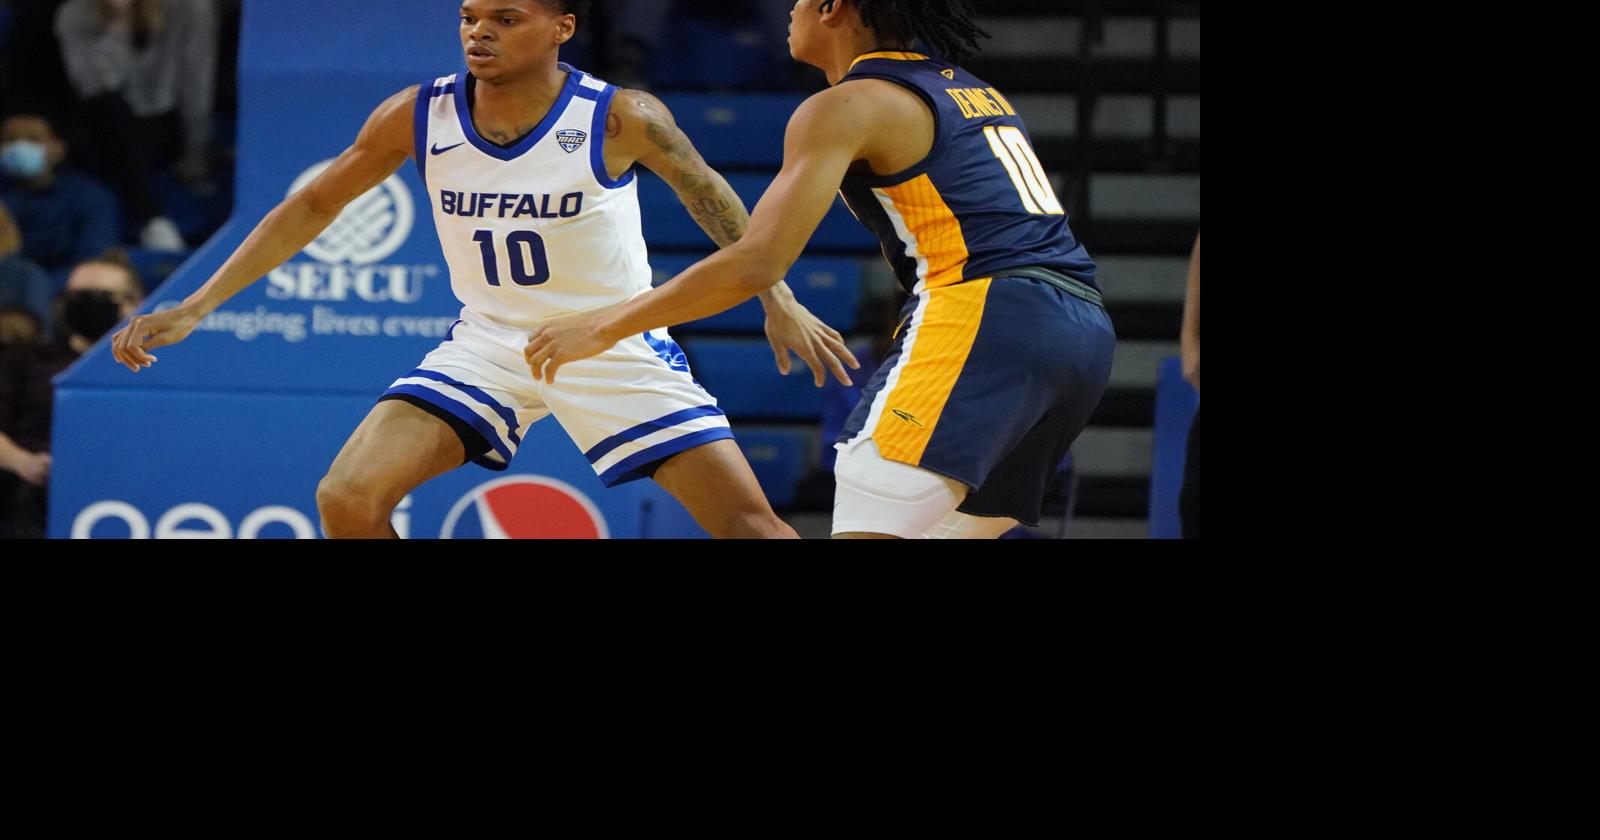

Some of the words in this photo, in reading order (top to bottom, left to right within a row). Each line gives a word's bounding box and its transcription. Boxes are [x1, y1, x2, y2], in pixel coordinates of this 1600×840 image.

[982, 125, 1065, 215] 10
[440, 189, 584, 219] BUFFALO
[472, 229, 550, 287] 10
[265, 263, 424, 303] SEFCU
[312, 304, 380, 336] lives
[383, 315, 458, 338] ever
